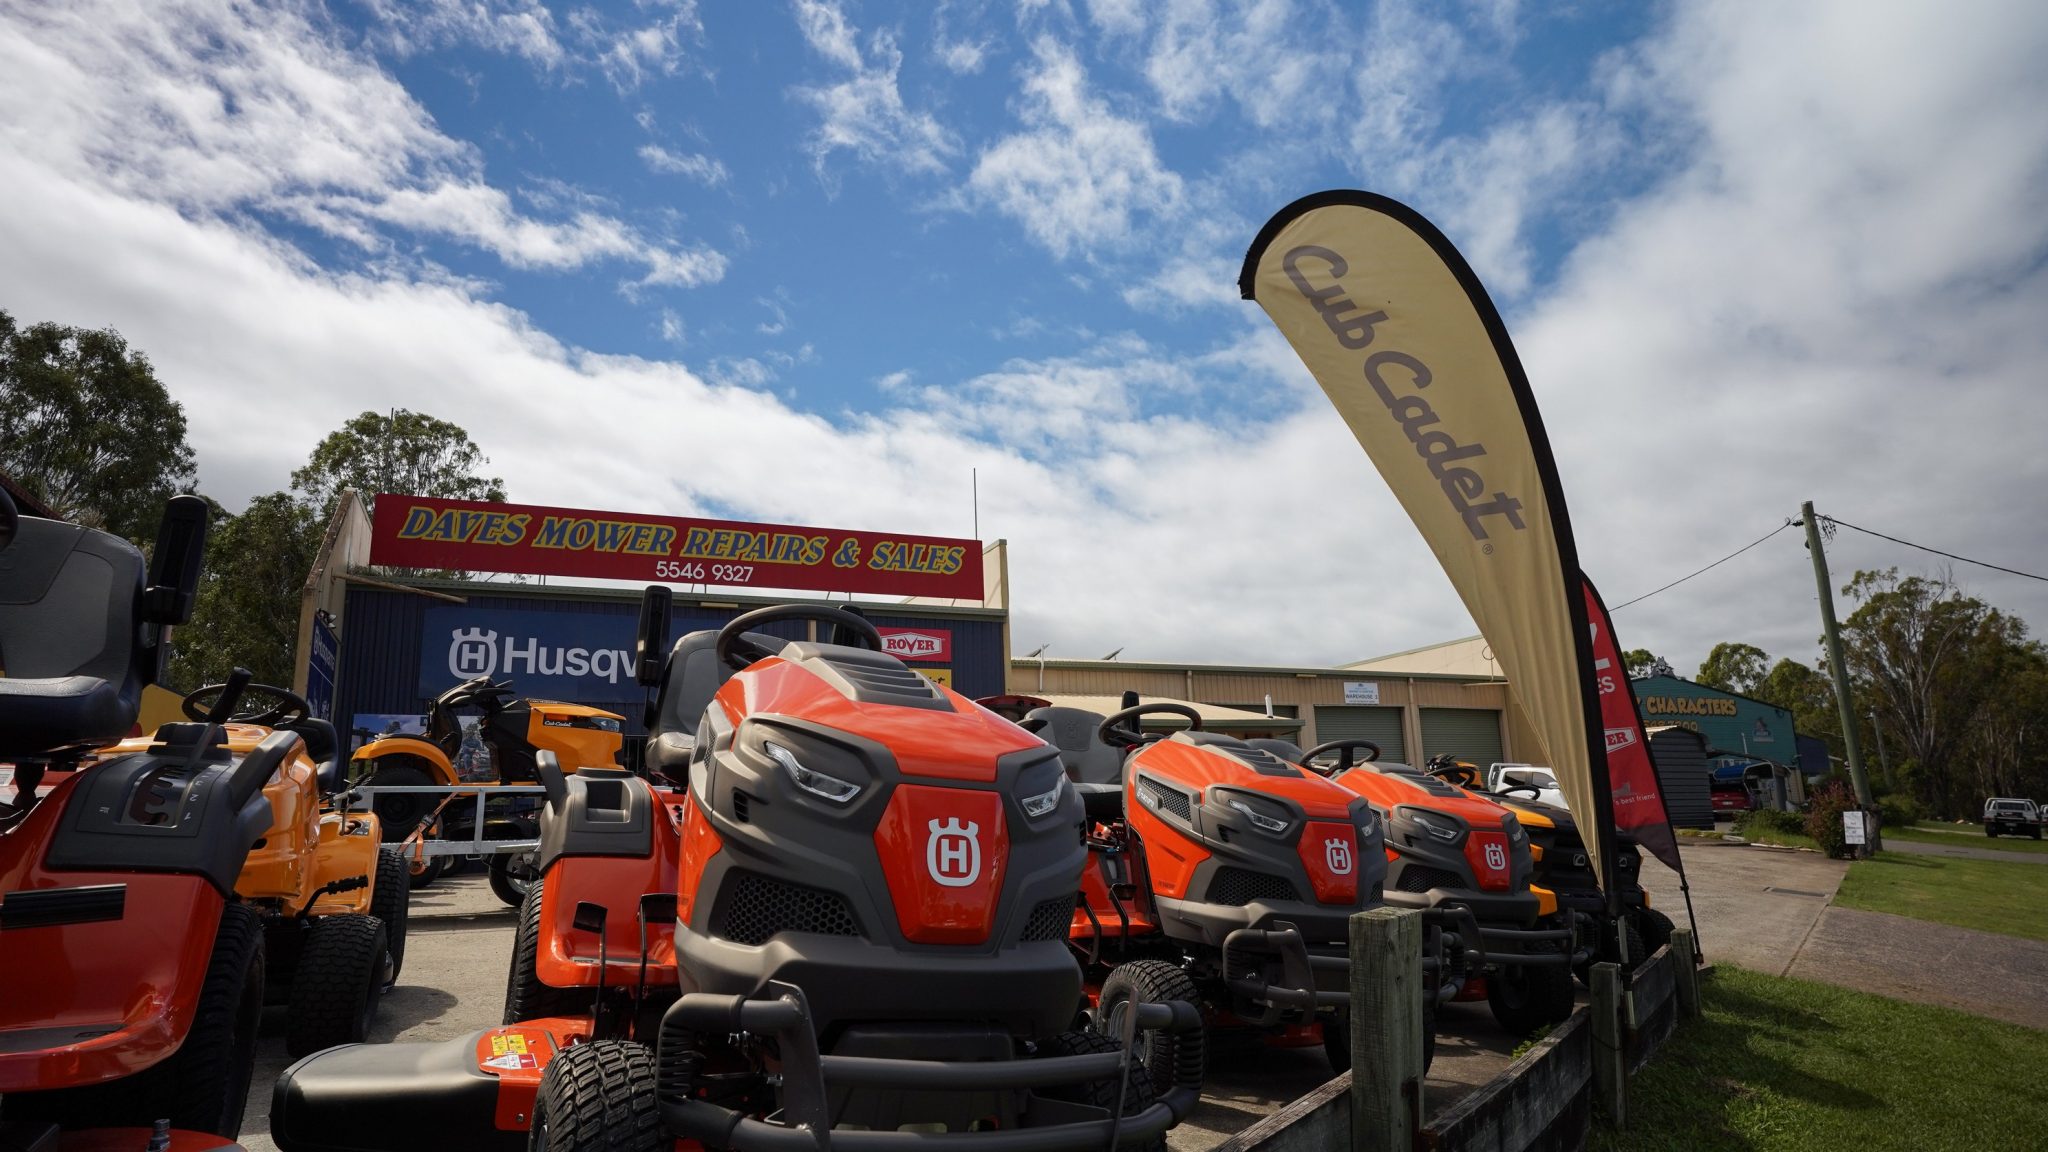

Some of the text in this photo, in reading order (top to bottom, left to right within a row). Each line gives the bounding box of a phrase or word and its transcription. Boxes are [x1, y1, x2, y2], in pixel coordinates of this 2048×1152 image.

[1282, 244, 1526, 541] Cub Cadet
[398, 506, 967, 575] DAVES MOWER REPAIRS & SALES
[656, 560, 753, 583] 5546 9327
[887, 636, 935, 654] ROVER
[1646, 696, 1737, 717] CHARACTERS
